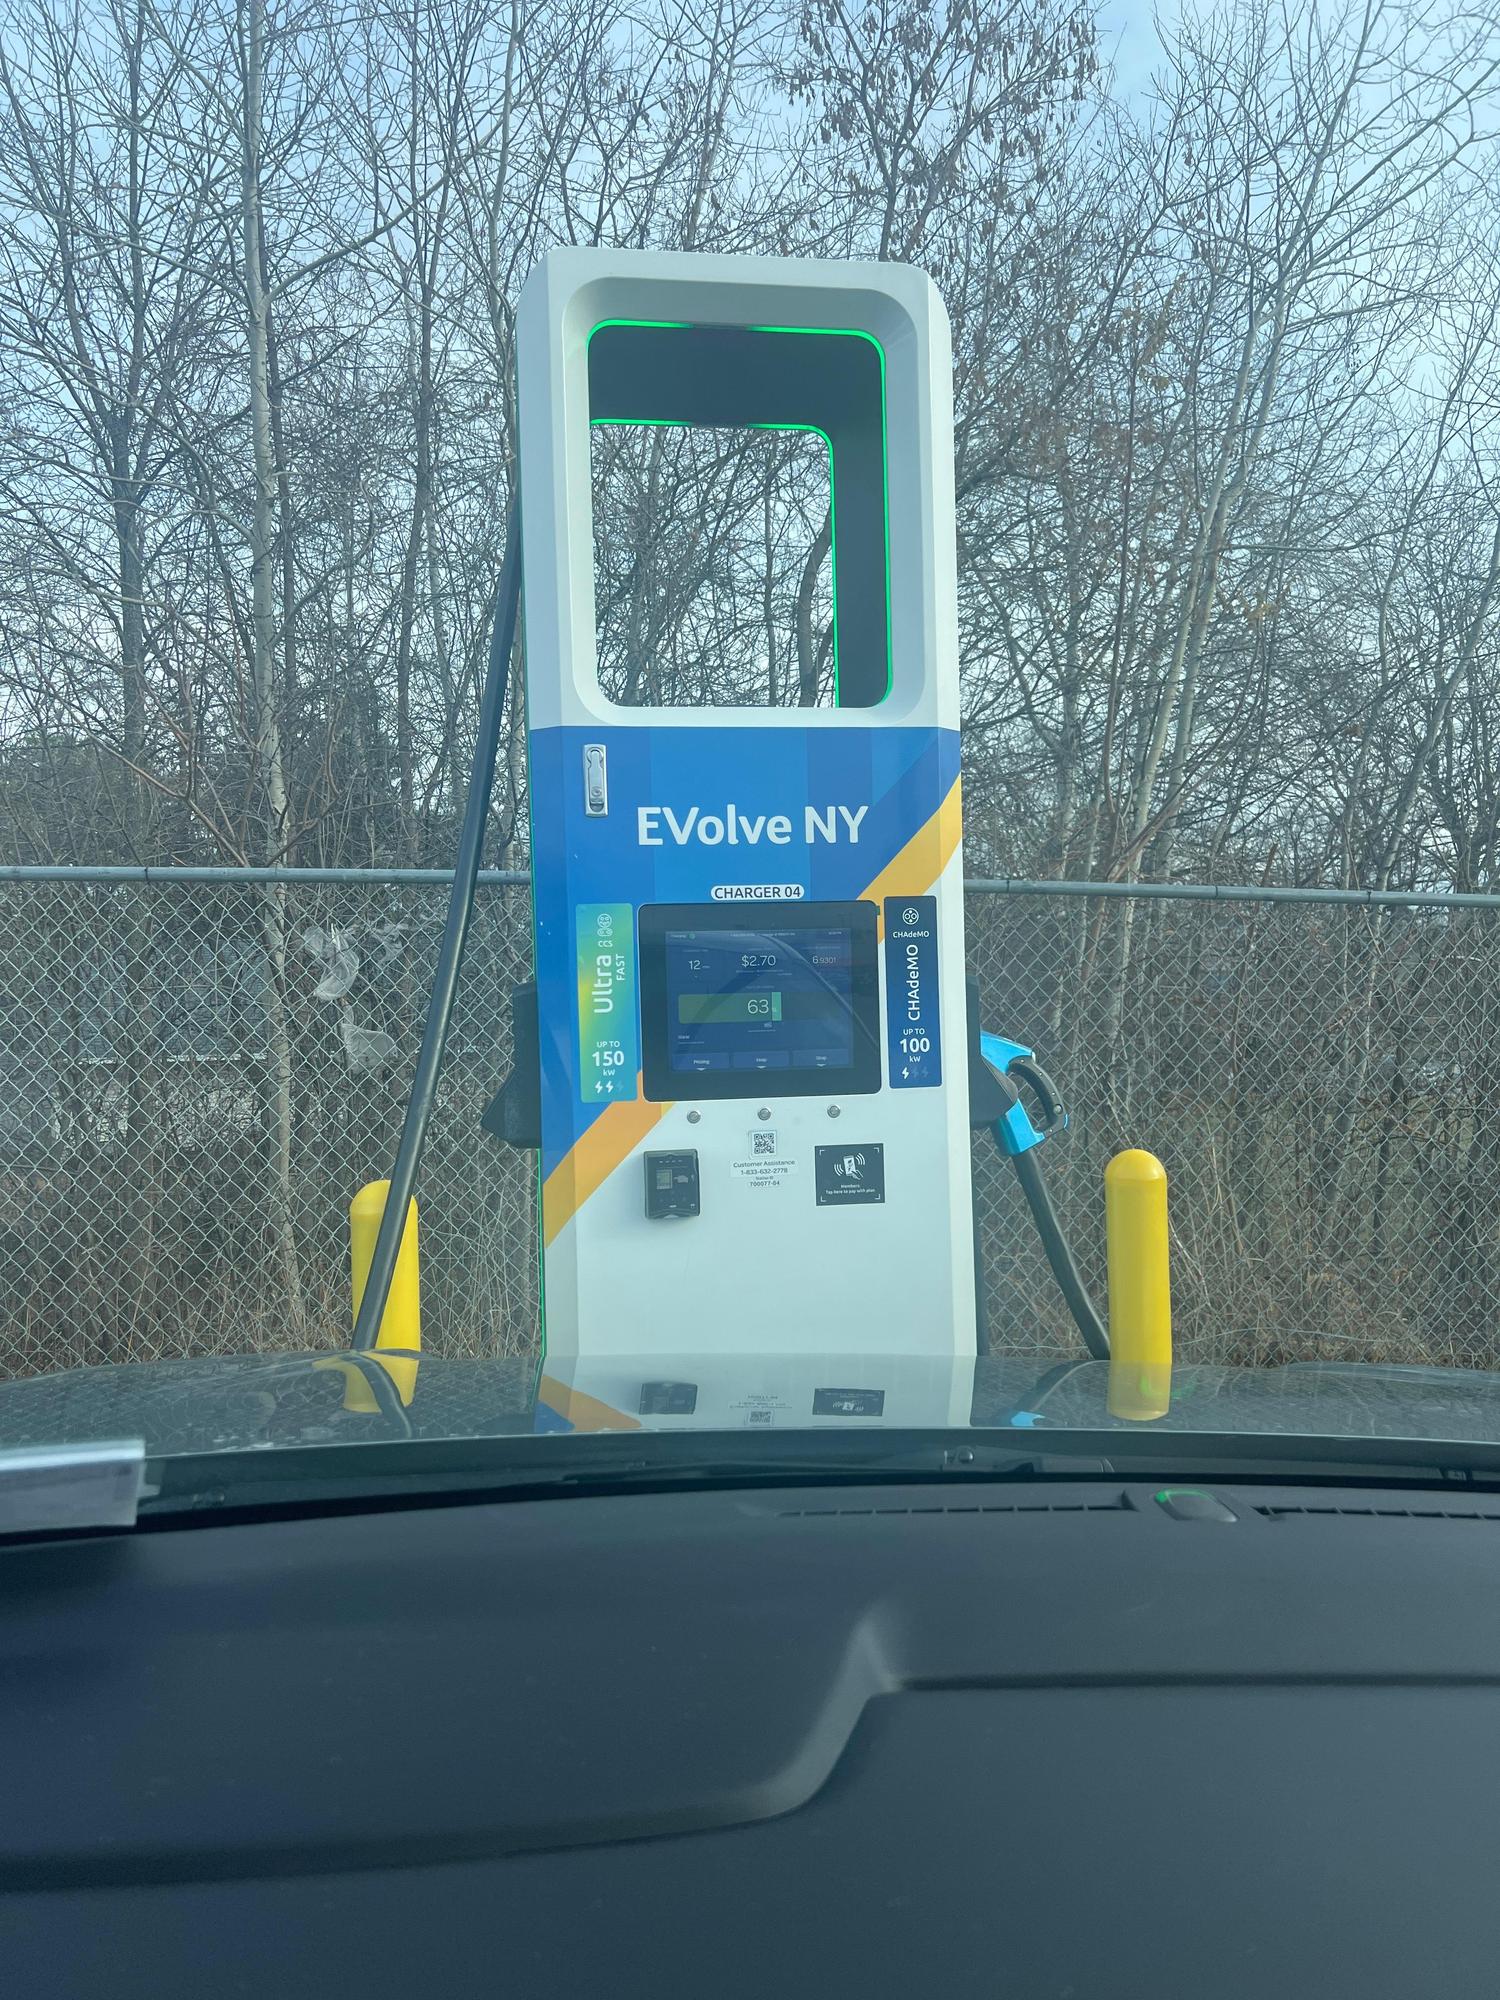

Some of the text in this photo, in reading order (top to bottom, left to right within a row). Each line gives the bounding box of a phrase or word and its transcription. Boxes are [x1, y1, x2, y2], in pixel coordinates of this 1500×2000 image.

[637, 803, 869, 846] EVolve NY
[714, 886, 801, 899] CHARGER 04
[892, 930, 930, 938] CHAdeMO
[615, 953, 626, 981] FAST
[688, 959, 701, 970] 12
[741, 954, 776, 968] $2.70
[592, 954, 614, 1014] Ultra
[906, 944, 921, 1021] CHAdeMO
[747, 999, 769, 1014] 63
[903, 1027, 925, 1036] UP TO
[609, 1040, 620, 1048] TO
[900, 1037, 930, 1053] 100
[592, 1050, 625, 1067] 150
[909, 1055, 921, 1063] kW
[603, 1068, 615, 1077] kW
